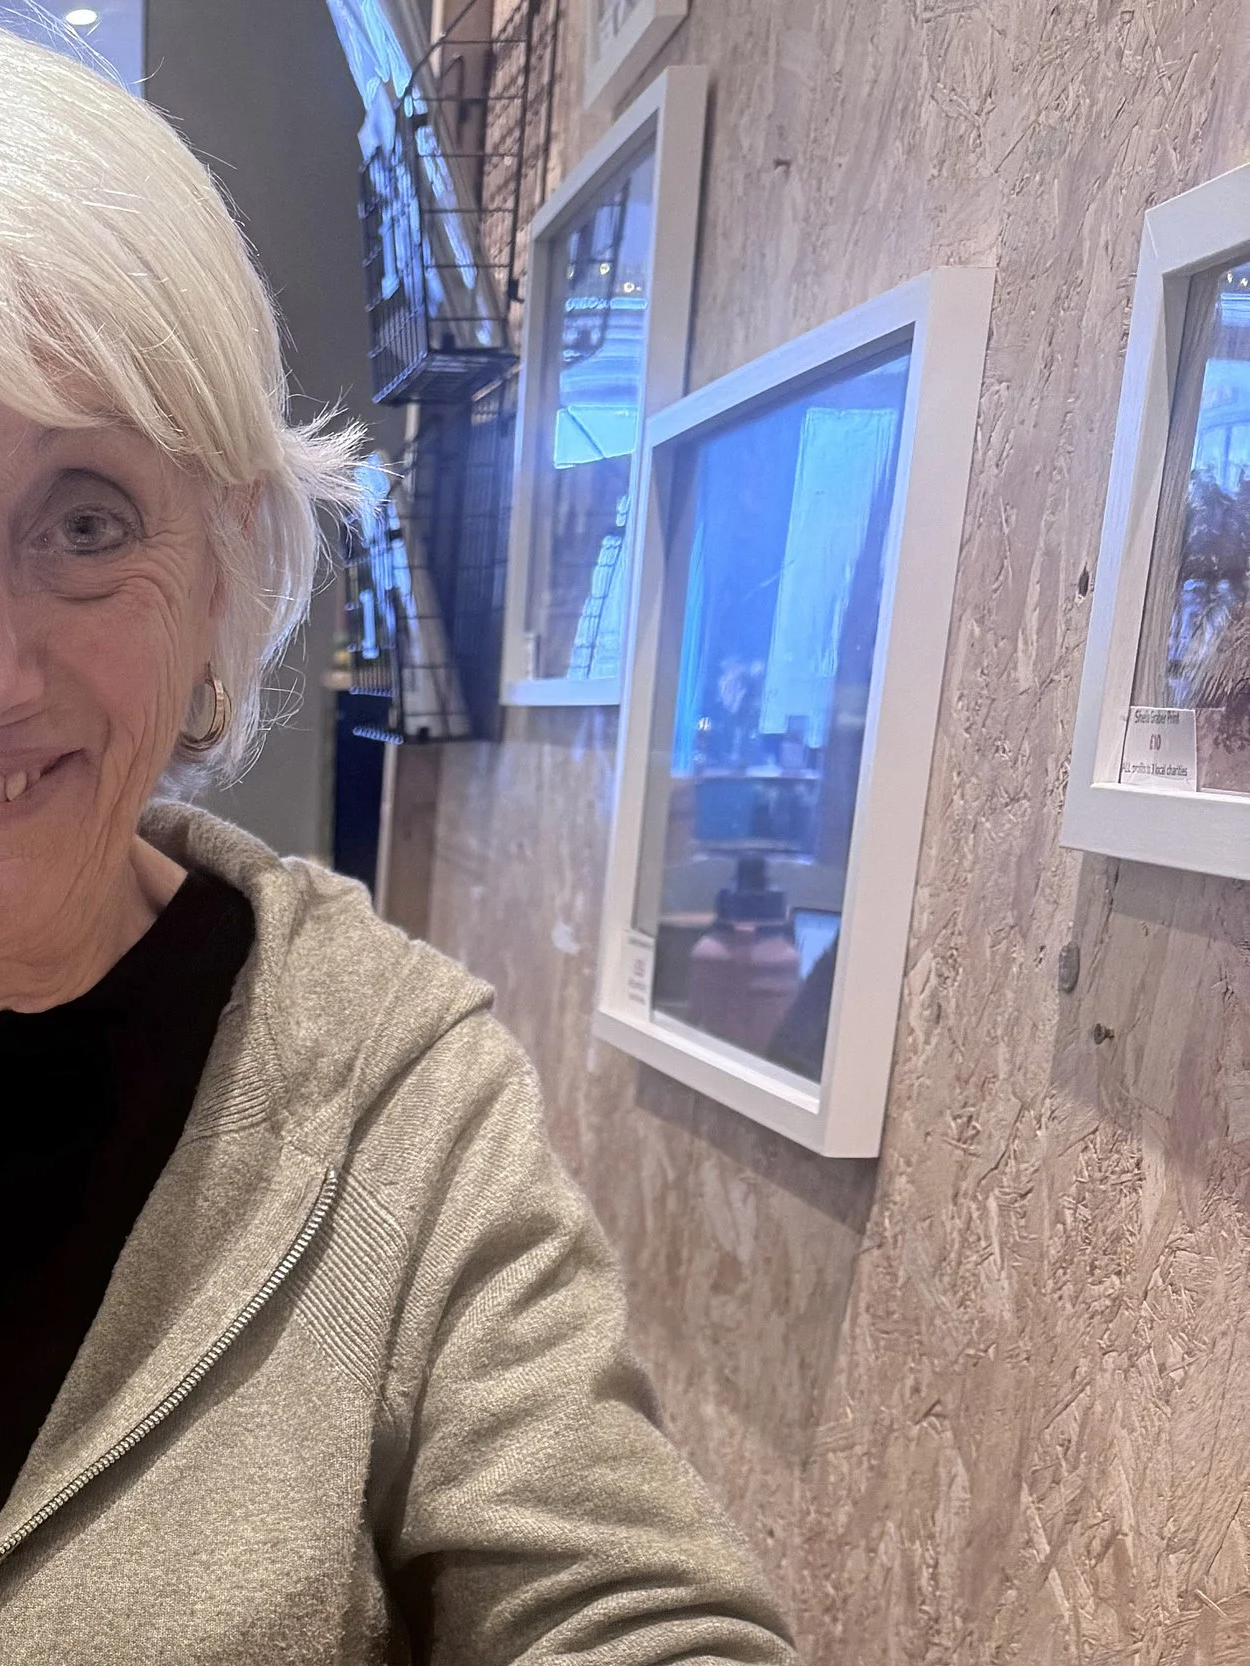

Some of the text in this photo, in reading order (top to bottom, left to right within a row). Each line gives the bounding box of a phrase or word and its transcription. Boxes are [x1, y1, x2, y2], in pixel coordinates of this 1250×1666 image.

[1149, 734, 1161, 751] £10
[1155, 764, 1166, 775] local
[1166, 764, 1188, 777] charities
